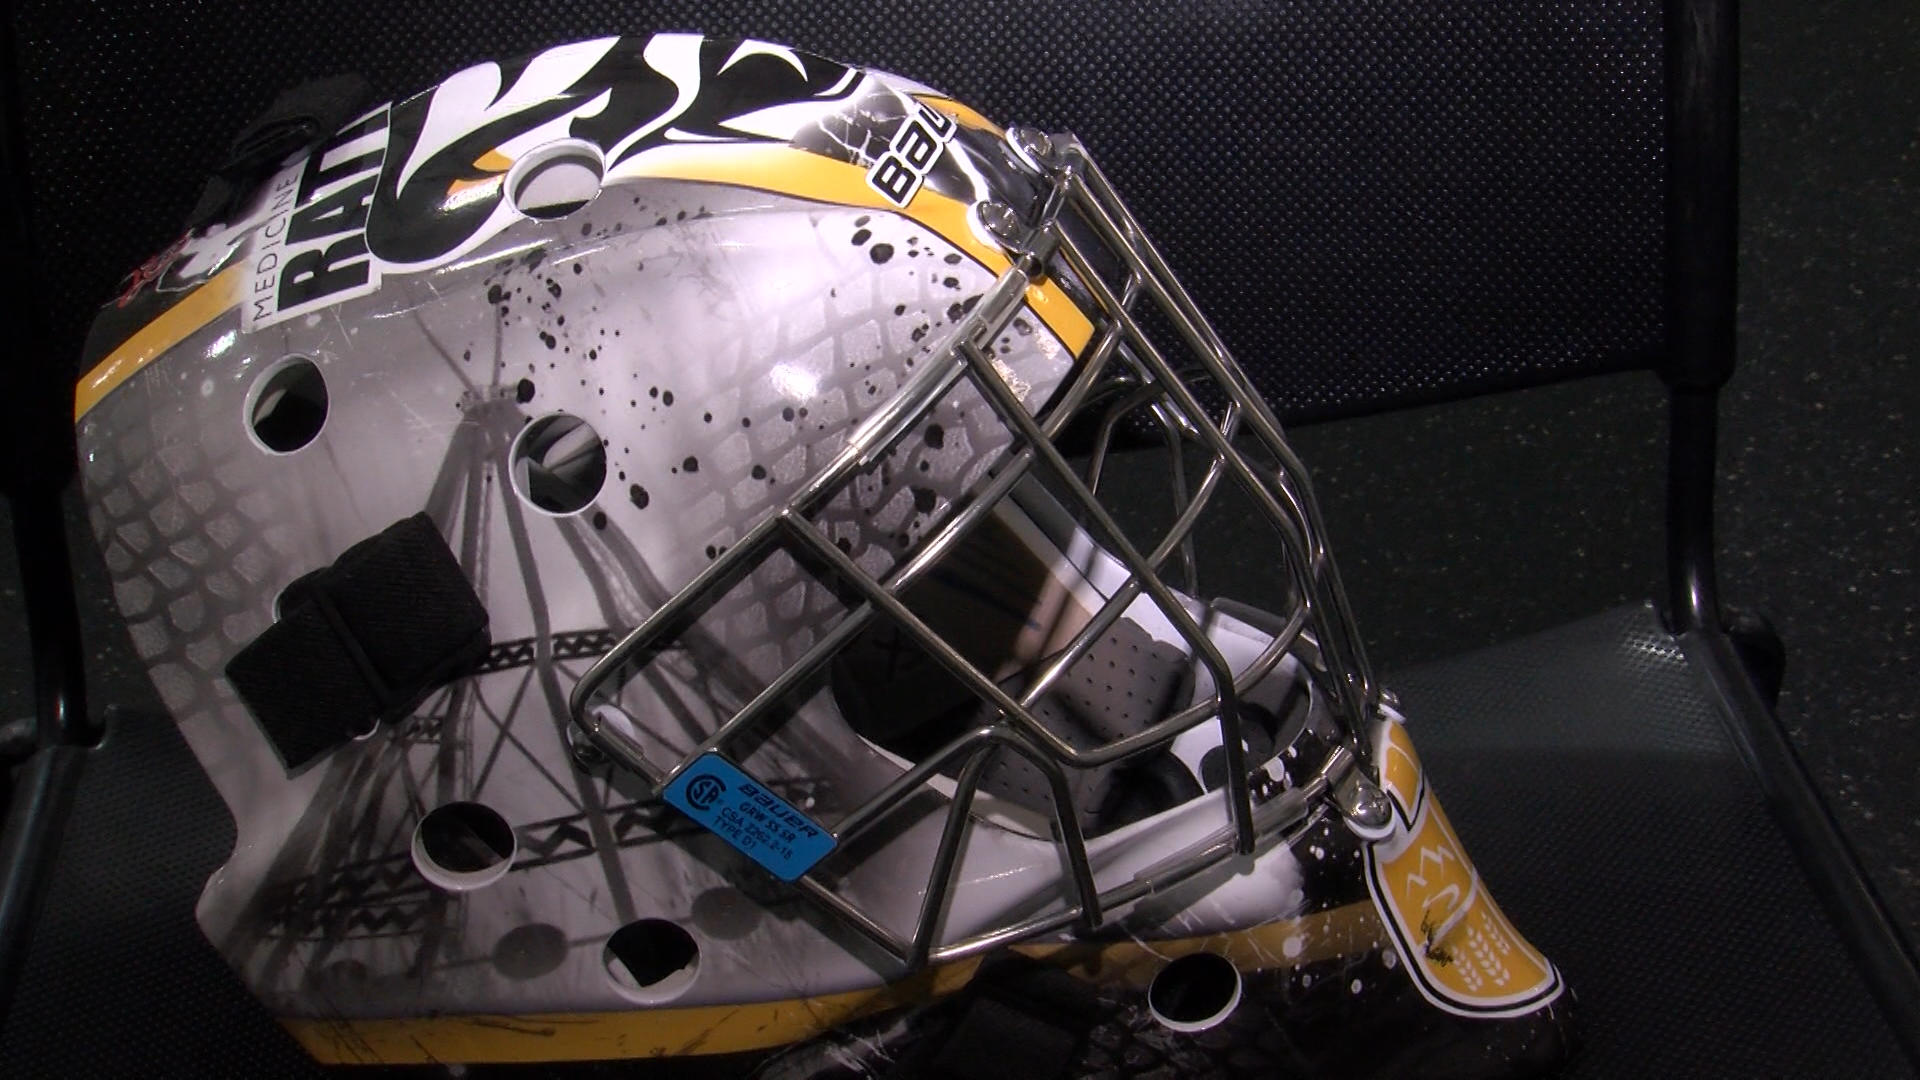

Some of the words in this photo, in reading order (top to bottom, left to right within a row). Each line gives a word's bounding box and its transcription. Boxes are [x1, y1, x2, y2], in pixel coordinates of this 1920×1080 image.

[253, 174, 299, 322] MEDICINE
[721, 806, 744, 827] CSA
[738, 783, 819, 838] BAUER
[713, 815, 743, 839] TYPE
[741, 836, 757, 849] D1
[779, 828, 796, 843] SR
